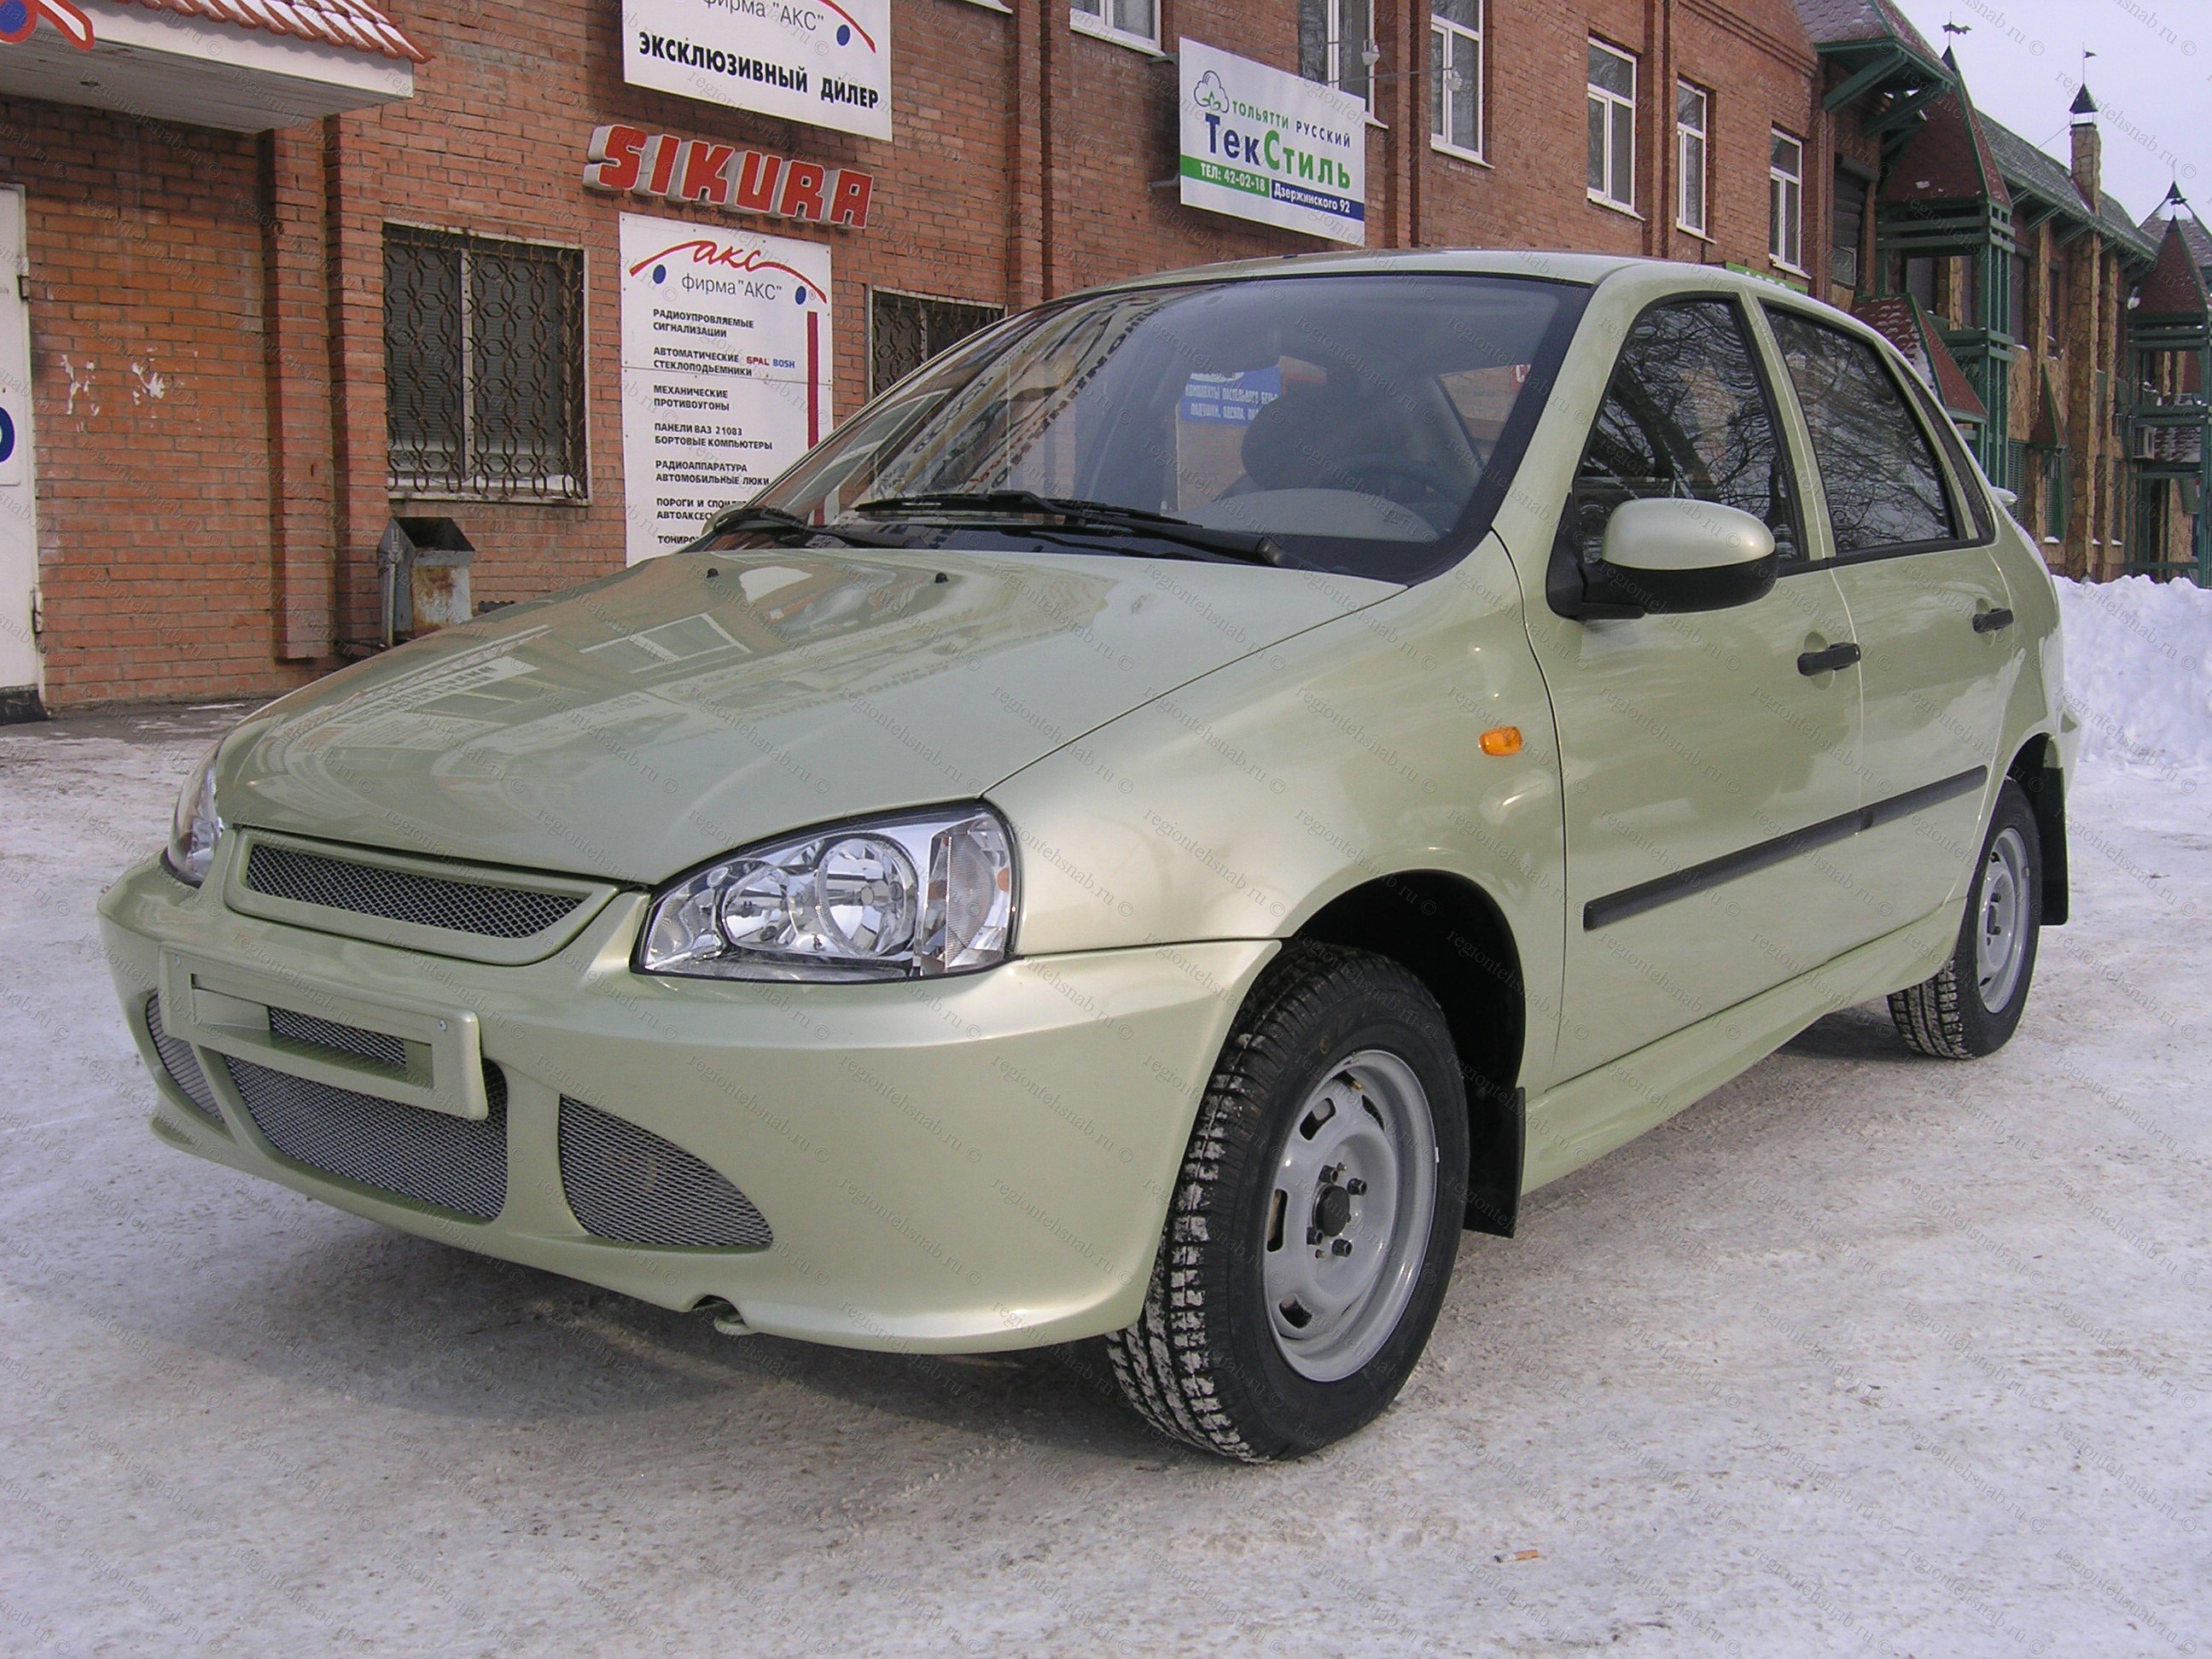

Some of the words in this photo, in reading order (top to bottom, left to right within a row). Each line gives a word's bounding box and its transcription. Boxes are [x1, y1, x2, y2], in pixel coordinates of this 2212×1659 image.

[638, 31, 808, 93] ЭКСКЛЮЗИВНЫЙ
[819, 75, 878, 109] ДИЛЕР
[1231, 100, 1289, 130] ТОЛЬЯТТИ
[1295, 120, 1351, 148] РУССКИЙ
[1204, 112, 1351, 189] ТекСтиль
[587, 124, 874, 229] SIKURA
[1200, 163, 1221, 181] ТЕЛ:
[1224, 169, 1266, 192] 42-02-18
[1274, 183, 1338, 211] Дзержинского
[1339, 199, 1351, 213] 92
[652, 321, 727, 338] СИГНАЛИЗАЦИИ
[654, 346, 739, 363] АВТОМАТИЧЕСКИЕ
[772, 358, 795, 369] BOSH
[653, 385, 728, 399] МЕХАНИЧЕСКИЕ
[654, 398, 730, 411] ПРОТИВОУГОНЫ
[654, 422, 693, 434] ПАНЕЛИ
[694, 424, 713, 434] ВАЗ
[715, 426, 742, 436] 21083
[655, 435, 707, 446] БОРТОВЫЕ
[707, 438, 773, 450] КОМПЬЮТЕРЫ
[655, 460, 748, 473] РАДИОАППАРАТУРА
[655, 473, 740, 485] АВТОМОБИЛЬНЫЕ
[742, 476, 770, 486] ЛЮКИ
[656, 498, 694, 508] ПОРОГИ
[696, 499, 704, 508] И
